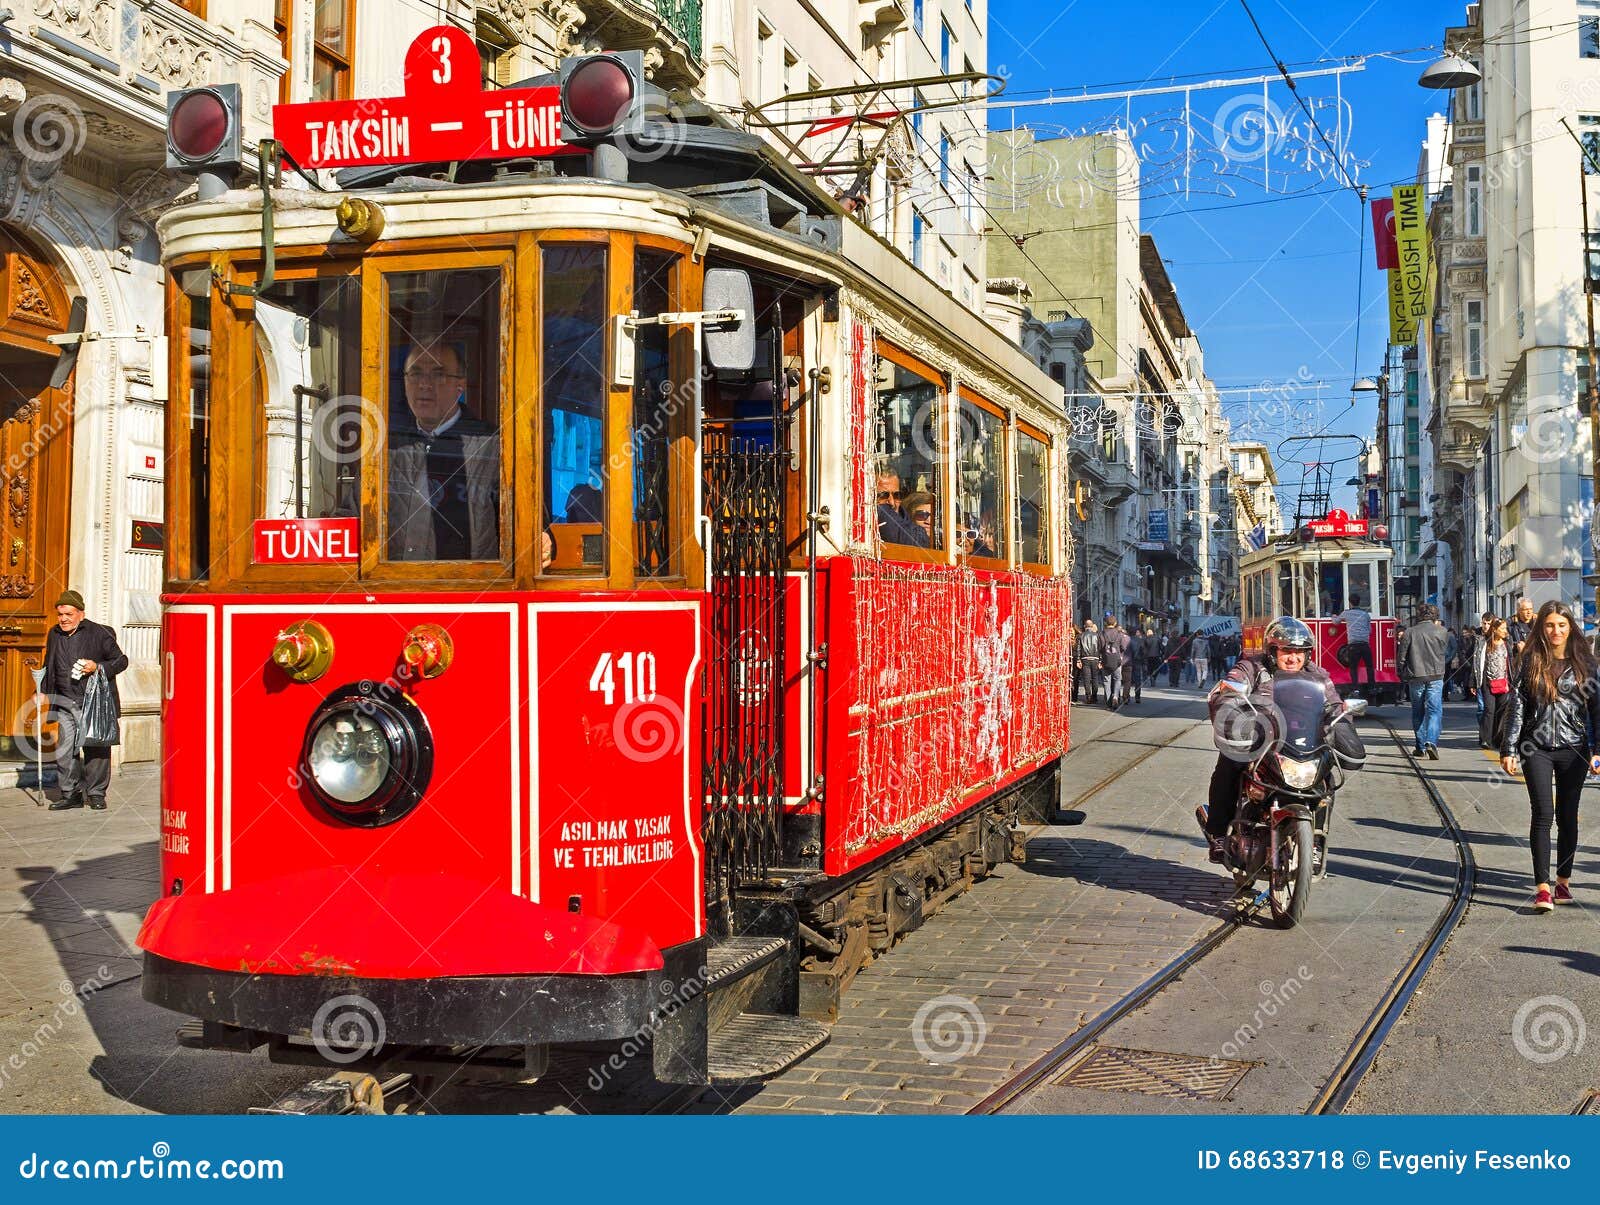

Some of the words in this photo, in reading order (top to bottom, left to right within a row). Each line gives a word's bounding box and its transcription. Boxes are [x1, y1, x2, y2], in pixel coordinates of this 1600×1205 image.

[431, 36, 452, 85] 3
[485, 100, 569, 151] TÜNE
[1400, 188, 1418, 232] TIME
[1402, 238, 1426, 317] ENGLISH
[261, 524, 359, 559] TÜNEL
[165, 651, 175, 700] 0
[589, 651, 656, 705] 410
[560, 818, 628, 842] ASILMAK
[634, 814, 671, 836] YASAK
[553, 846, 575, 869] VE
[582, 837, 674, 867] TEHLİKELİDİR
